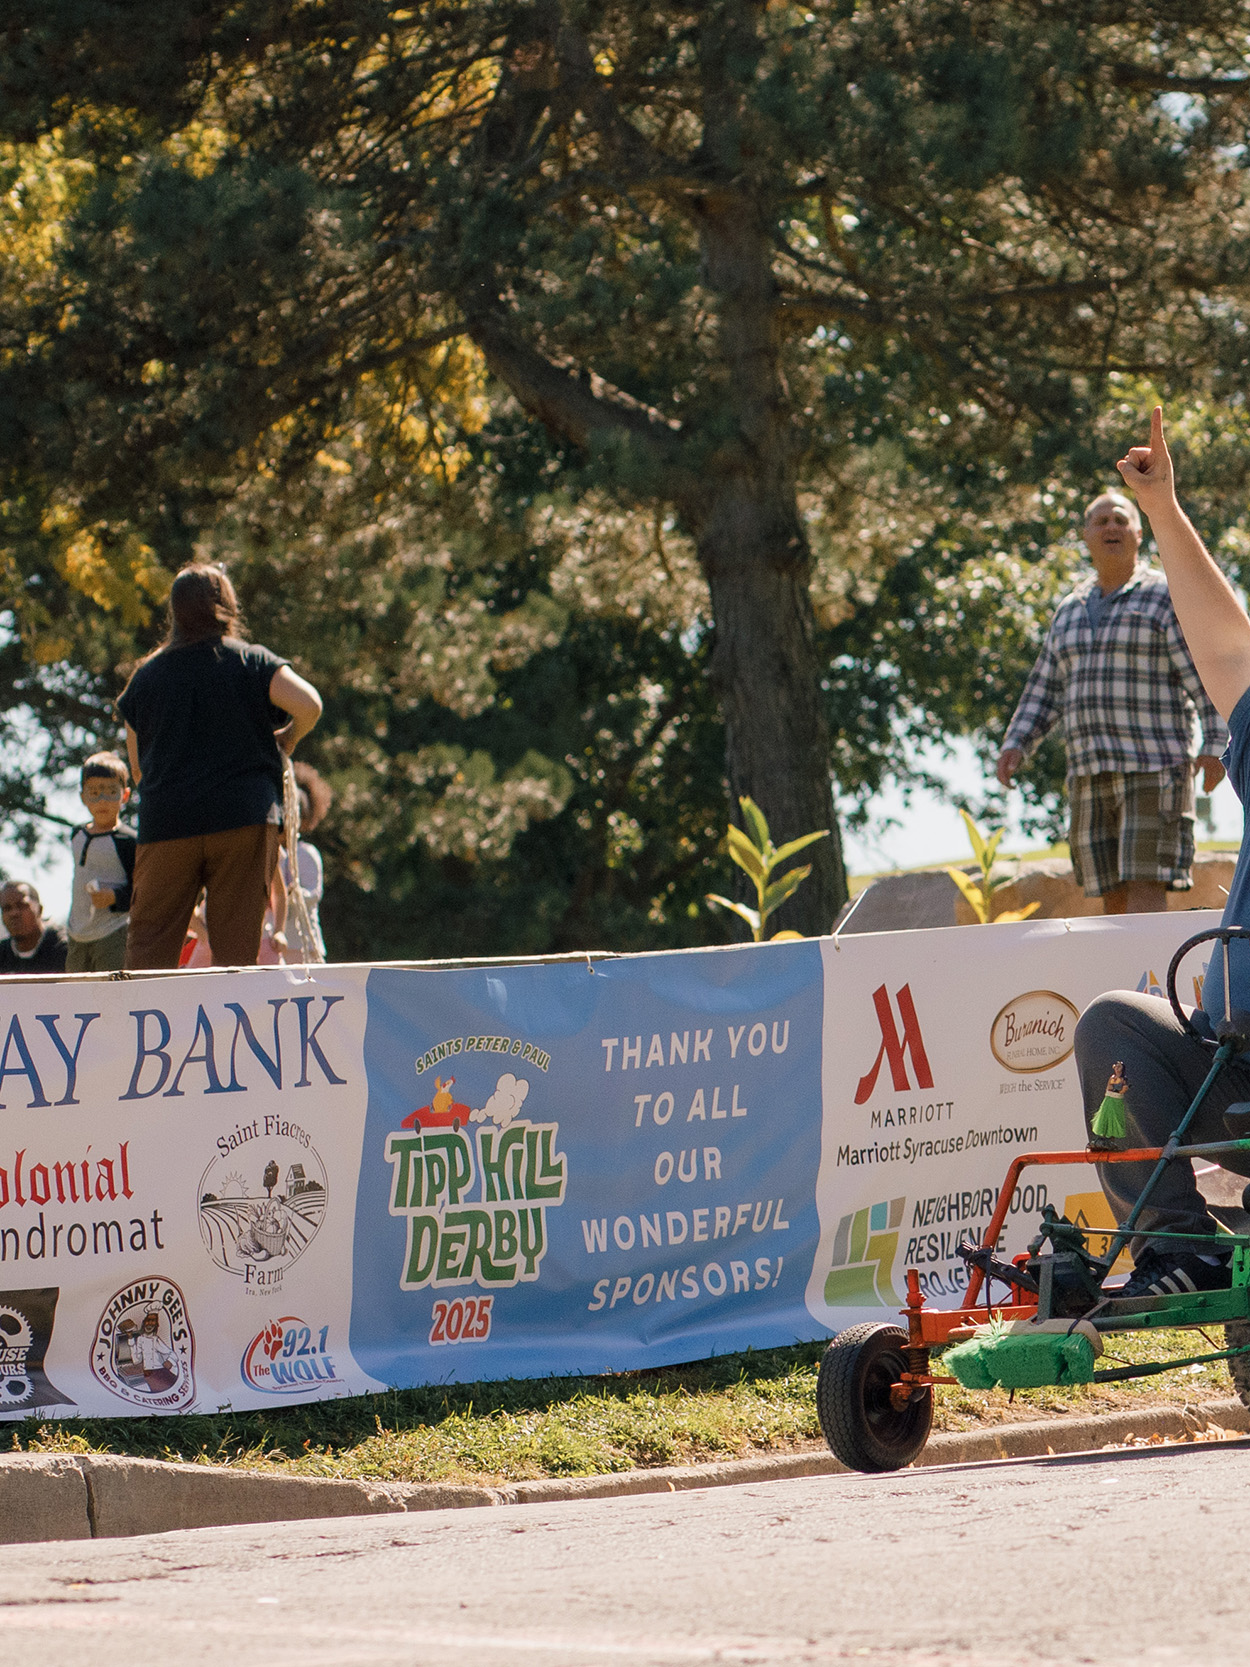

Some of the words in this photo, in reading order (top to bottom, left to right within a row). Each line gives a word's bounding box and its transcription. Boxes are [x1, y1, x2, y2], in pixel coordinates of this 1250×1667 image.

[118, 995, 348, 1102] BANK
[601, 1028, 714, 1072] THANK
[728, 1020, 790, 1058] YOU
[1004, 1011, 1065, 1047] Buranich
[415, 1038, 462, 1074] SAINTS
[465, 1036, 511, 1053] PETER
[511, 1040, 521, 1055] &
[522, 1042, 551, 1072] PAUL
[633, 1091, 674, 1127] TO
[686, 1084, 748, 1122] ALL
[1018, 1080, 1032, 1092] the
[216, 1120, 259, 1158] Saint
[263, 1114, 312, 1149] Fiacres
[870, 1102, 954, 1129] MARRIOTT
[653, 1146, 722, 1186] OUR
[836, 1140, 901, 1167] Marriott
[903, 1136, 964, 1164] Syracuse
[965, 1125, 1038, 1150] Downtown
[389, 1133, 472, 1209] TIPP
[480, 1126, 563, 1202] HILL
[581, 1198, 790, 1254] WONDERFUL
[912, 1184, 1048, 1228] NEIGHBOROOD
[1, 1209, 165, 1262] ndromat
[405, 1207, 543, 1283] DERBY
[904, 1224, 1008, 1266] RESILIENE
[243, 1263, 284, 1285] Farm
[587, 1256, 784, 1311] SPONSORS!
[904, 1267, 978, 1298] ROJE
[99, 1282, 160, 1349] JOHNNY
[162, 1288, 188, 1342] GEE'S
[431, 1299, 492, 1342] 2025
[282, 1325, 329, 1357] 92.1
[98, 1366, 118, 1389] BBQ
[133, 1393, 180, 1407] CATERING
[253, 1364, 270, 1377] The
[269, 1356, 336, 1385] WOLF
